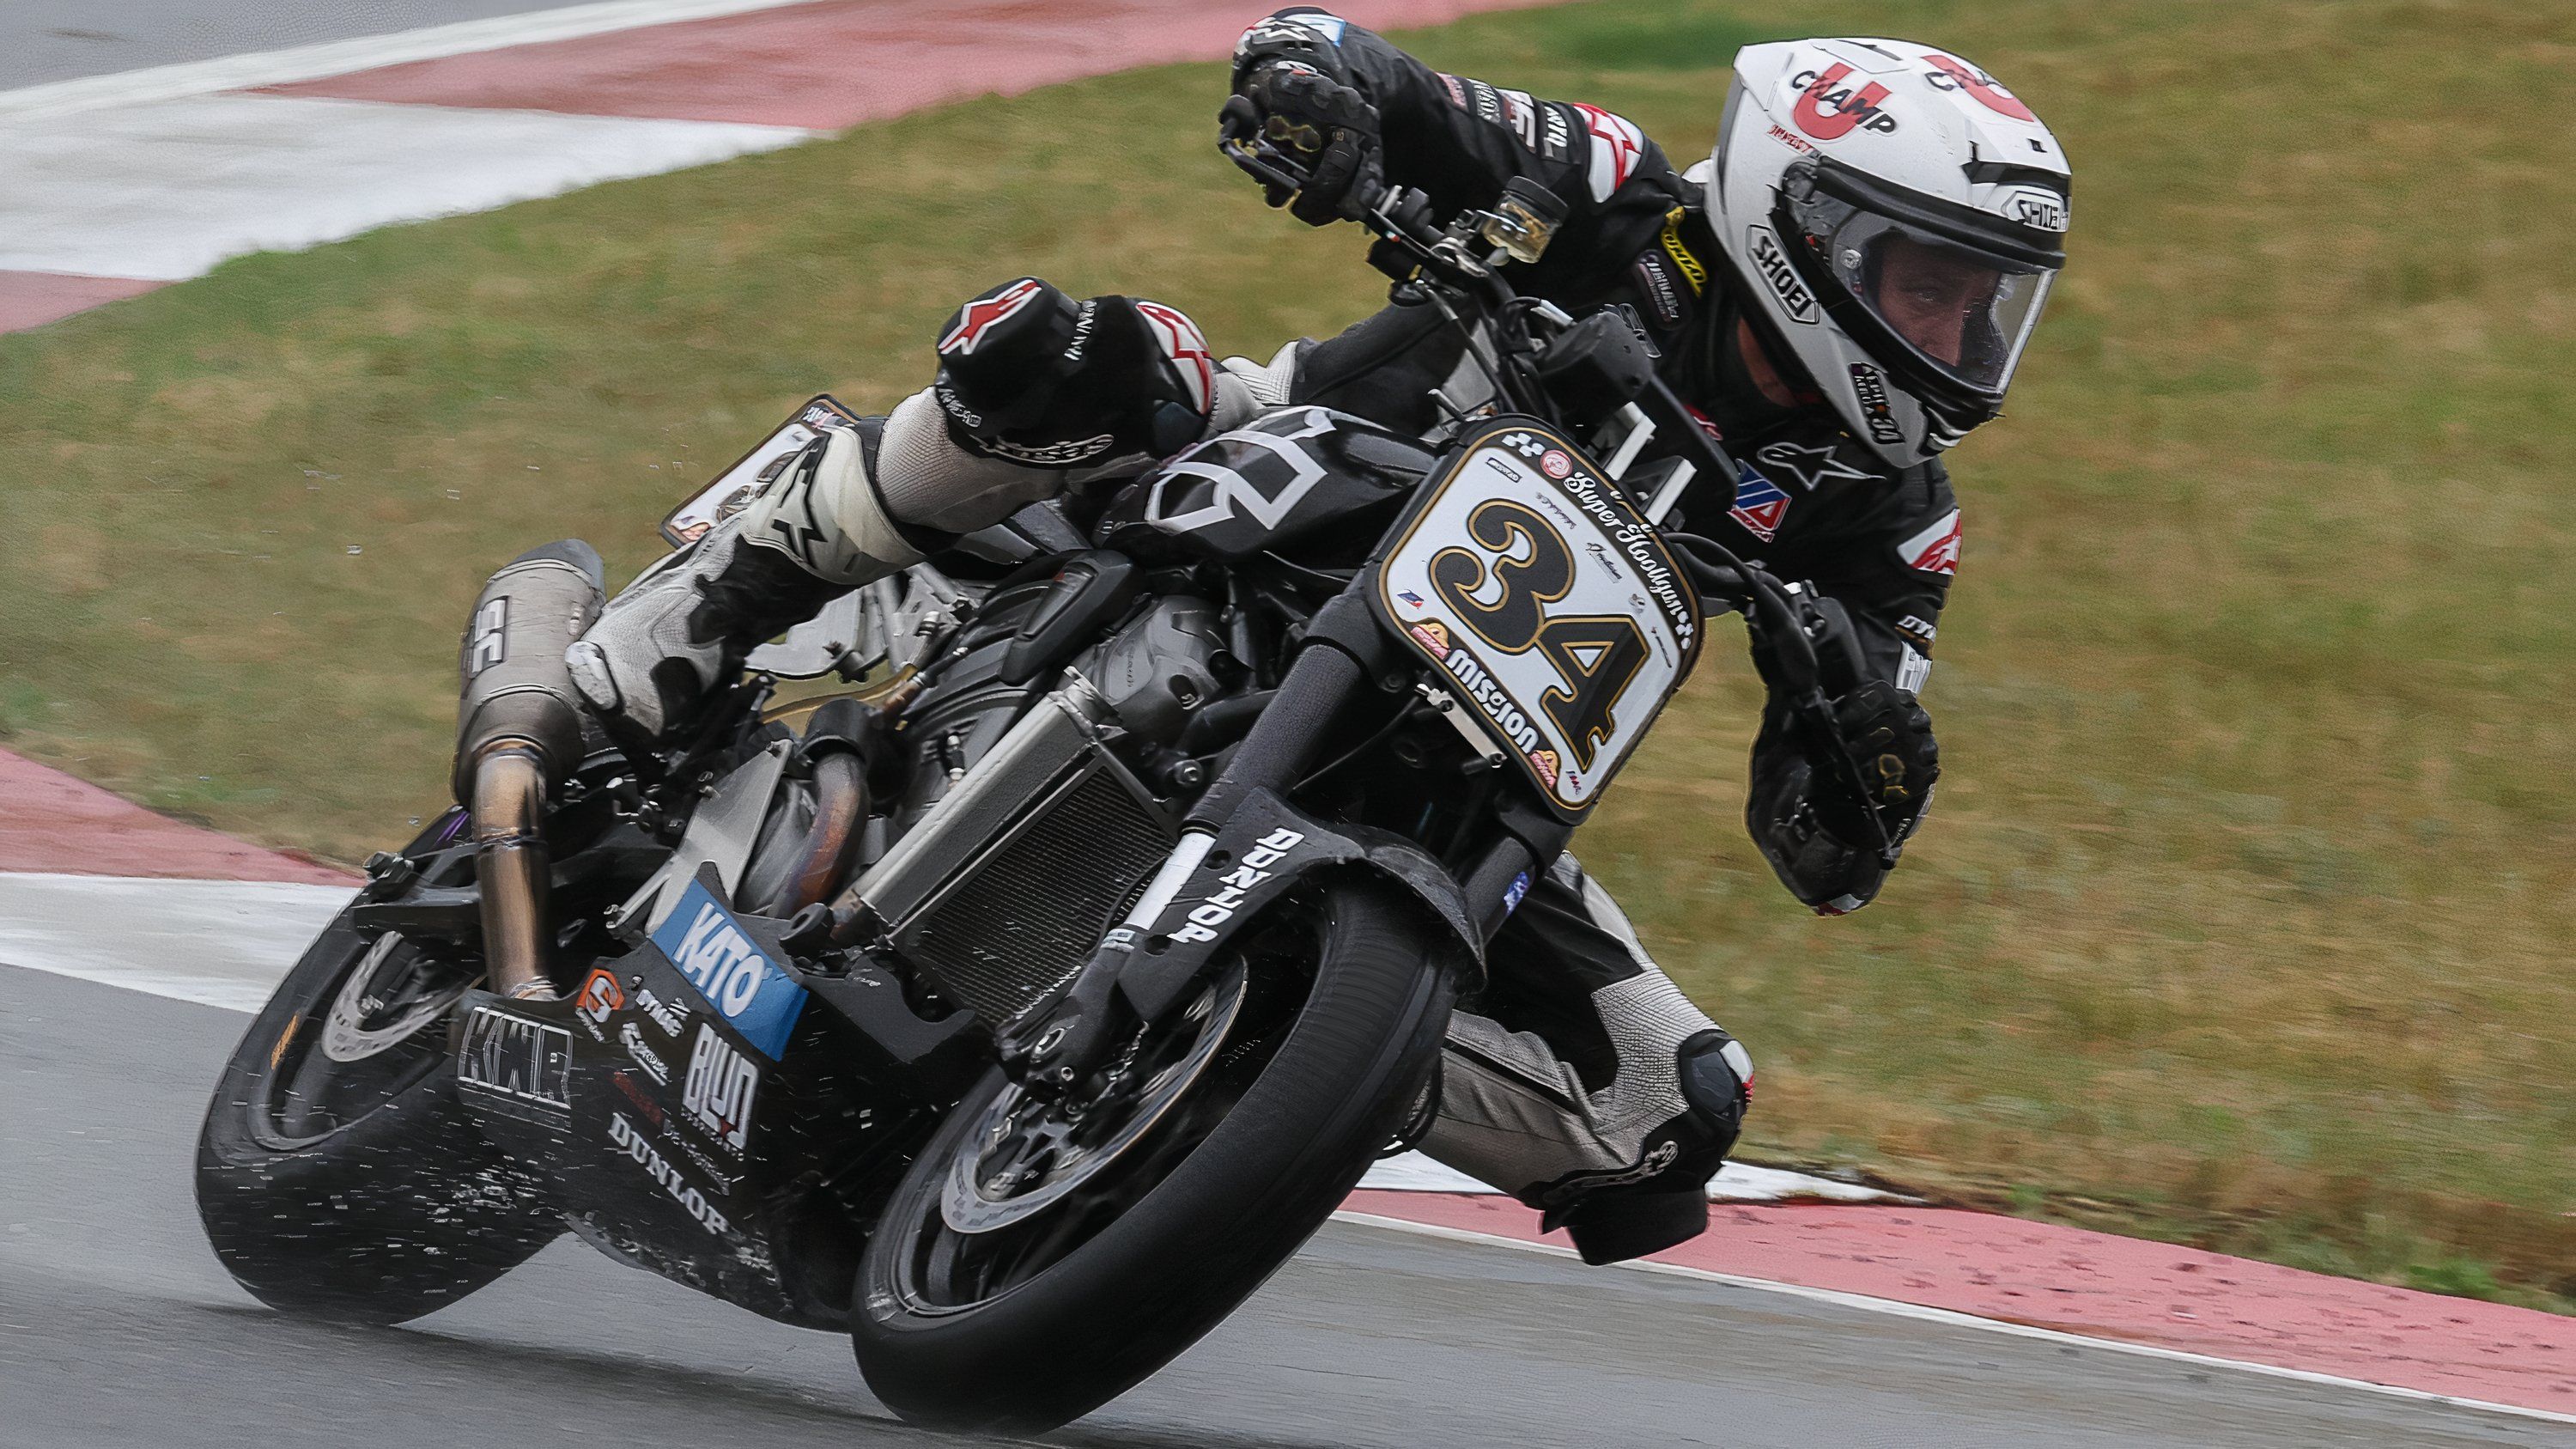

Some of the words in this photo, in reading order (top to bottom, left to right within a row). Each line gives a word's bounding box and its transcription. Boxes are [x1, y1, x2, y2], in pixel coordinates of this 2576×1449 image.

[1752, 234, 1813, 317] SHOEI
[1564, 472, 1625, 527] Super
[1430, 499, 1651, 771] 34
[1168, 827, 1304, 943] DUNLOP
[673, 902, 764, 1017] KATO
[607, 1112, 730, 1235] DUNLOP
